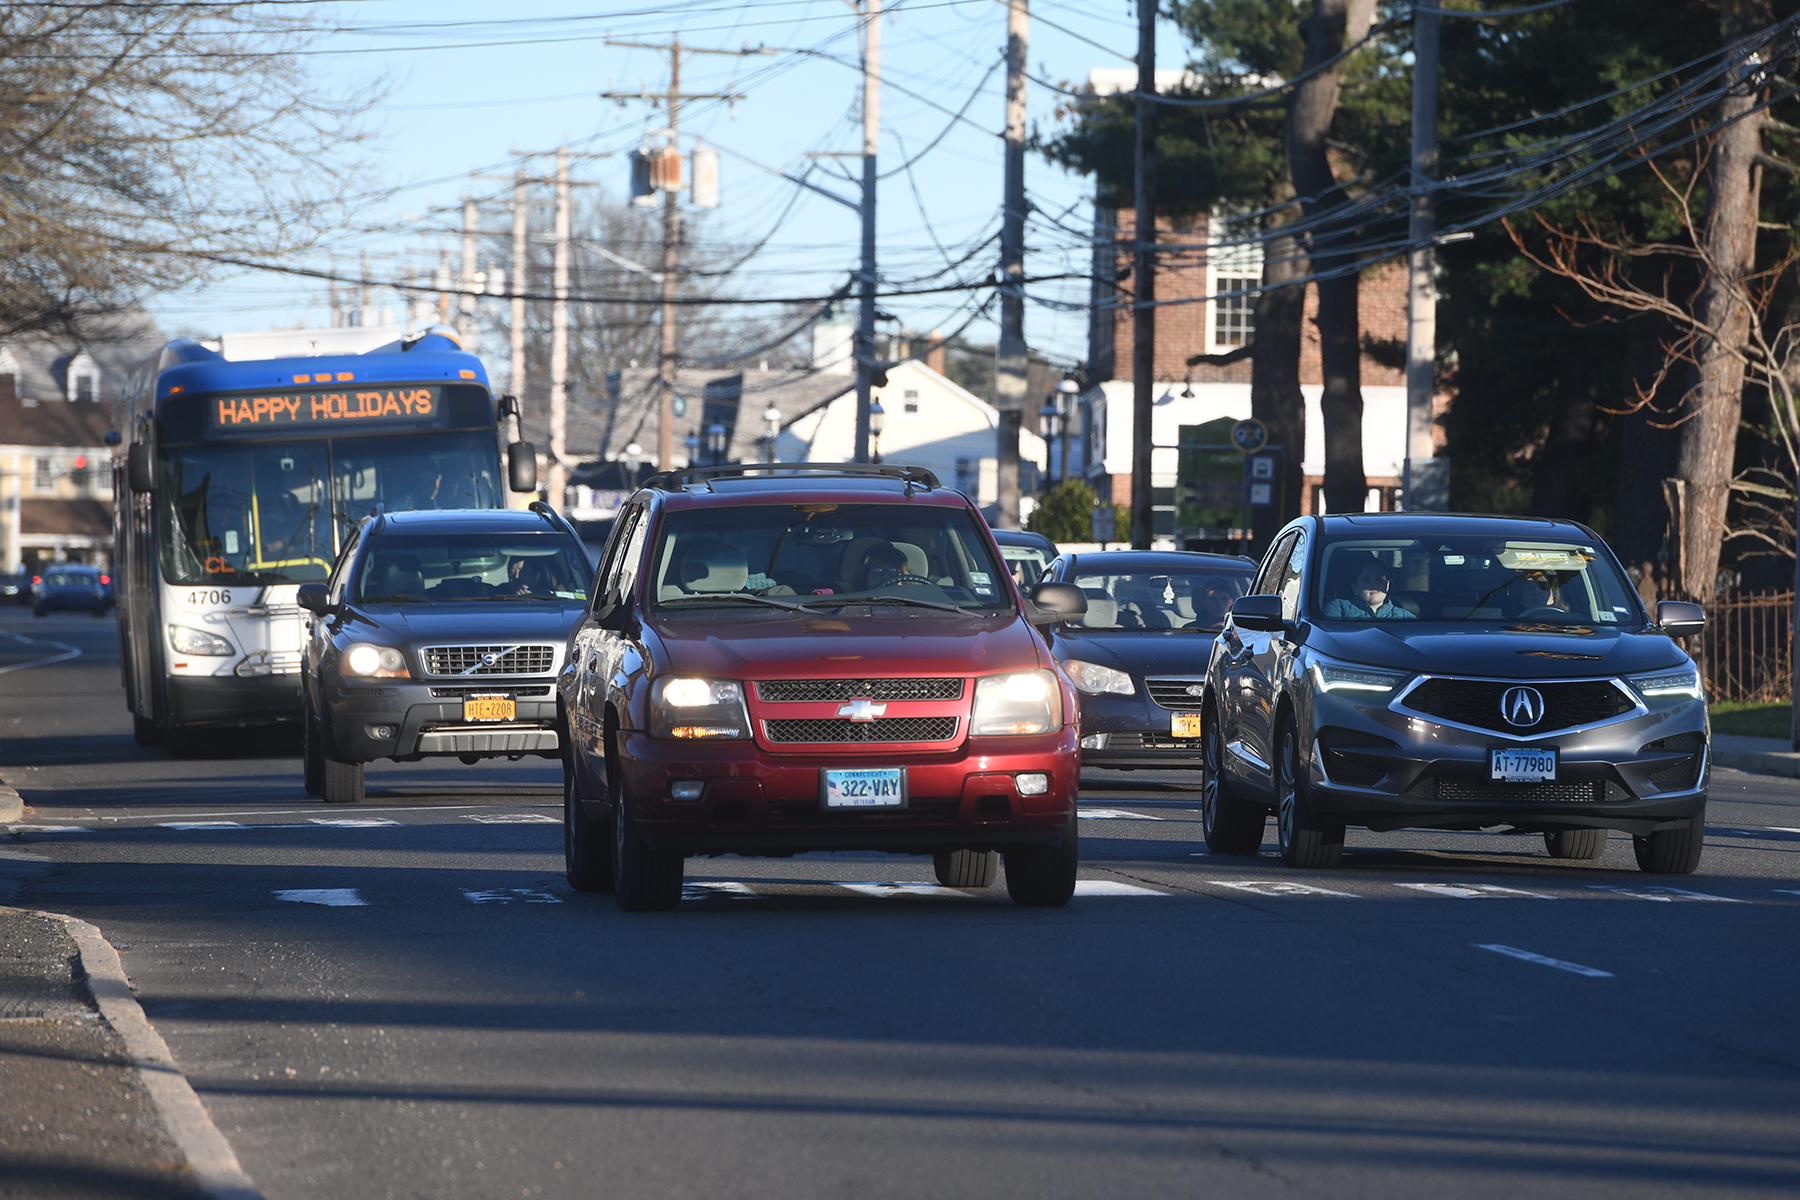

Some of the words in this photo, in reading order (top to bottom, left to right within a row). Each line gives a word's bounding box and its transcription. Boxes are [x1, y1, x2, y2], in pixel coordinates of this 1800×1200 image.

[218, 396, 301, 425] HAPPY
[310, 389, 432, 420] HOLIDAYS
[188, 589, 231, 606] 4706
[491, 702, 513, 716] 2208
